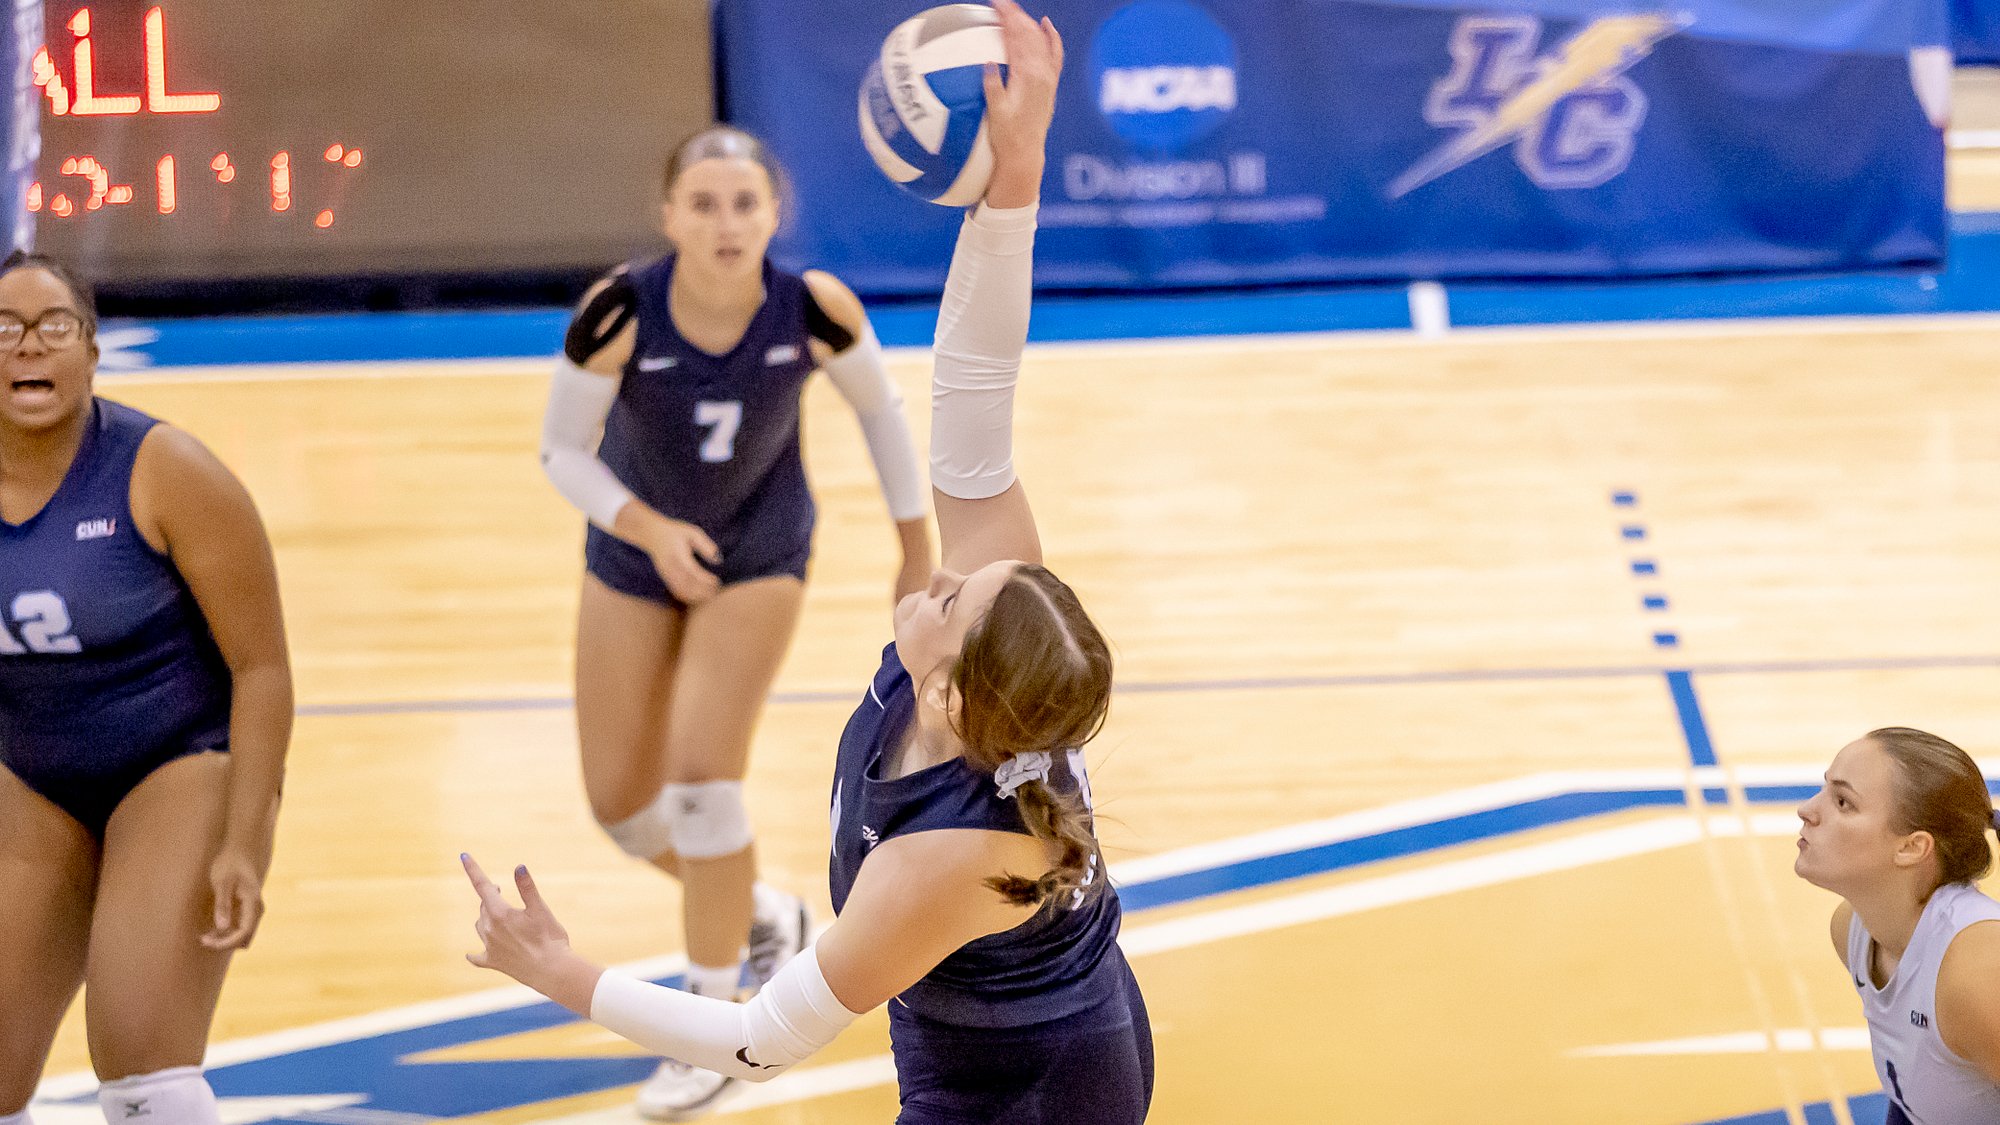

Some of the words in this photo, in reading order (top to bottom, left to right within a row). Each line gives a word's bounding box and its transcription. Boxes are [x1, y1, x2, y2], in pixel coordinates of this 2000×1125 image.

[1101, 66, 1236, 112] NCAA
[1064, 153, 1226, 200] Division
[694, 401, 743, 462] 7
